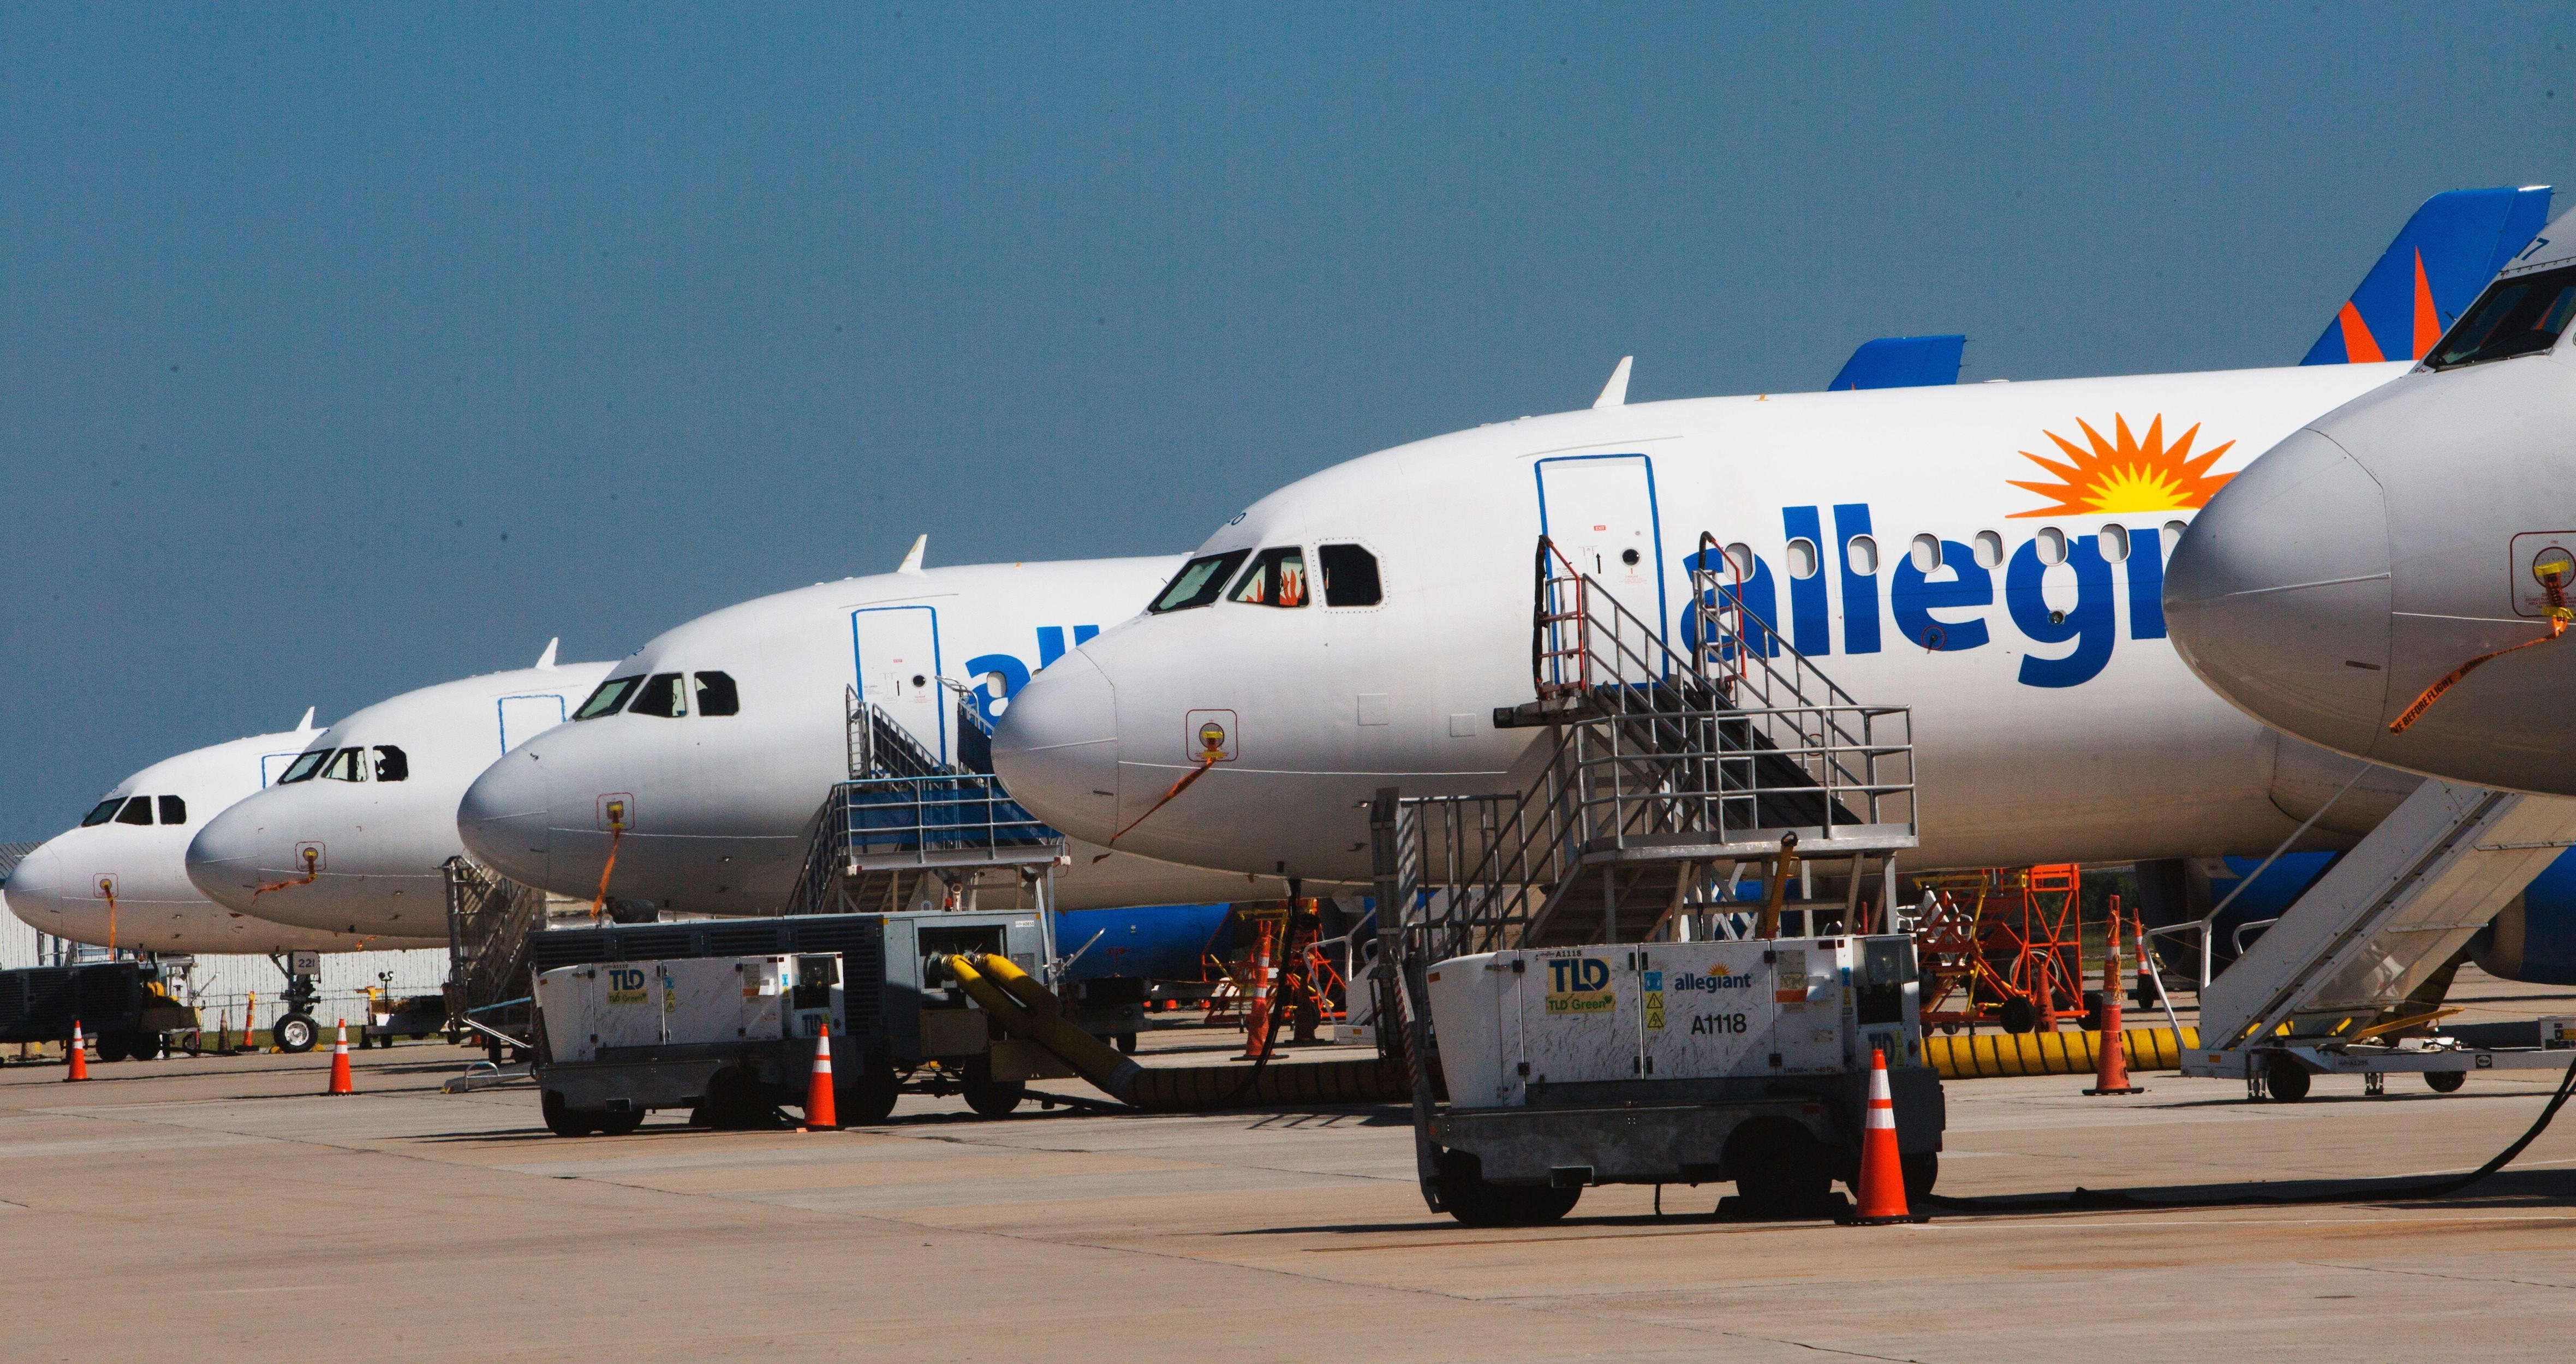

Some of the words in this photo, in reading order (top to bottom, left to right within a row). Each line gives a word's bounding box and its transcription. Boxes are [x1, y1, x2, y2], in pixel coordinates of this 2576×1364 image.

[2402, 697, 2429, 726] BEFORE
[2428, 676, 2453, 702] FLIGHT
[299, 958, 315, 968] 221
[609, 969, 645, 991] TLD
[1549, 958, 1609, 992] TLD
[1674, 973, 1751, 994] allegiant
[1548, 999, 1568, 1010] TLD
[1571, 998, 1607, 1010] Green
[1691, 1013, 1747, 1035] A1118
